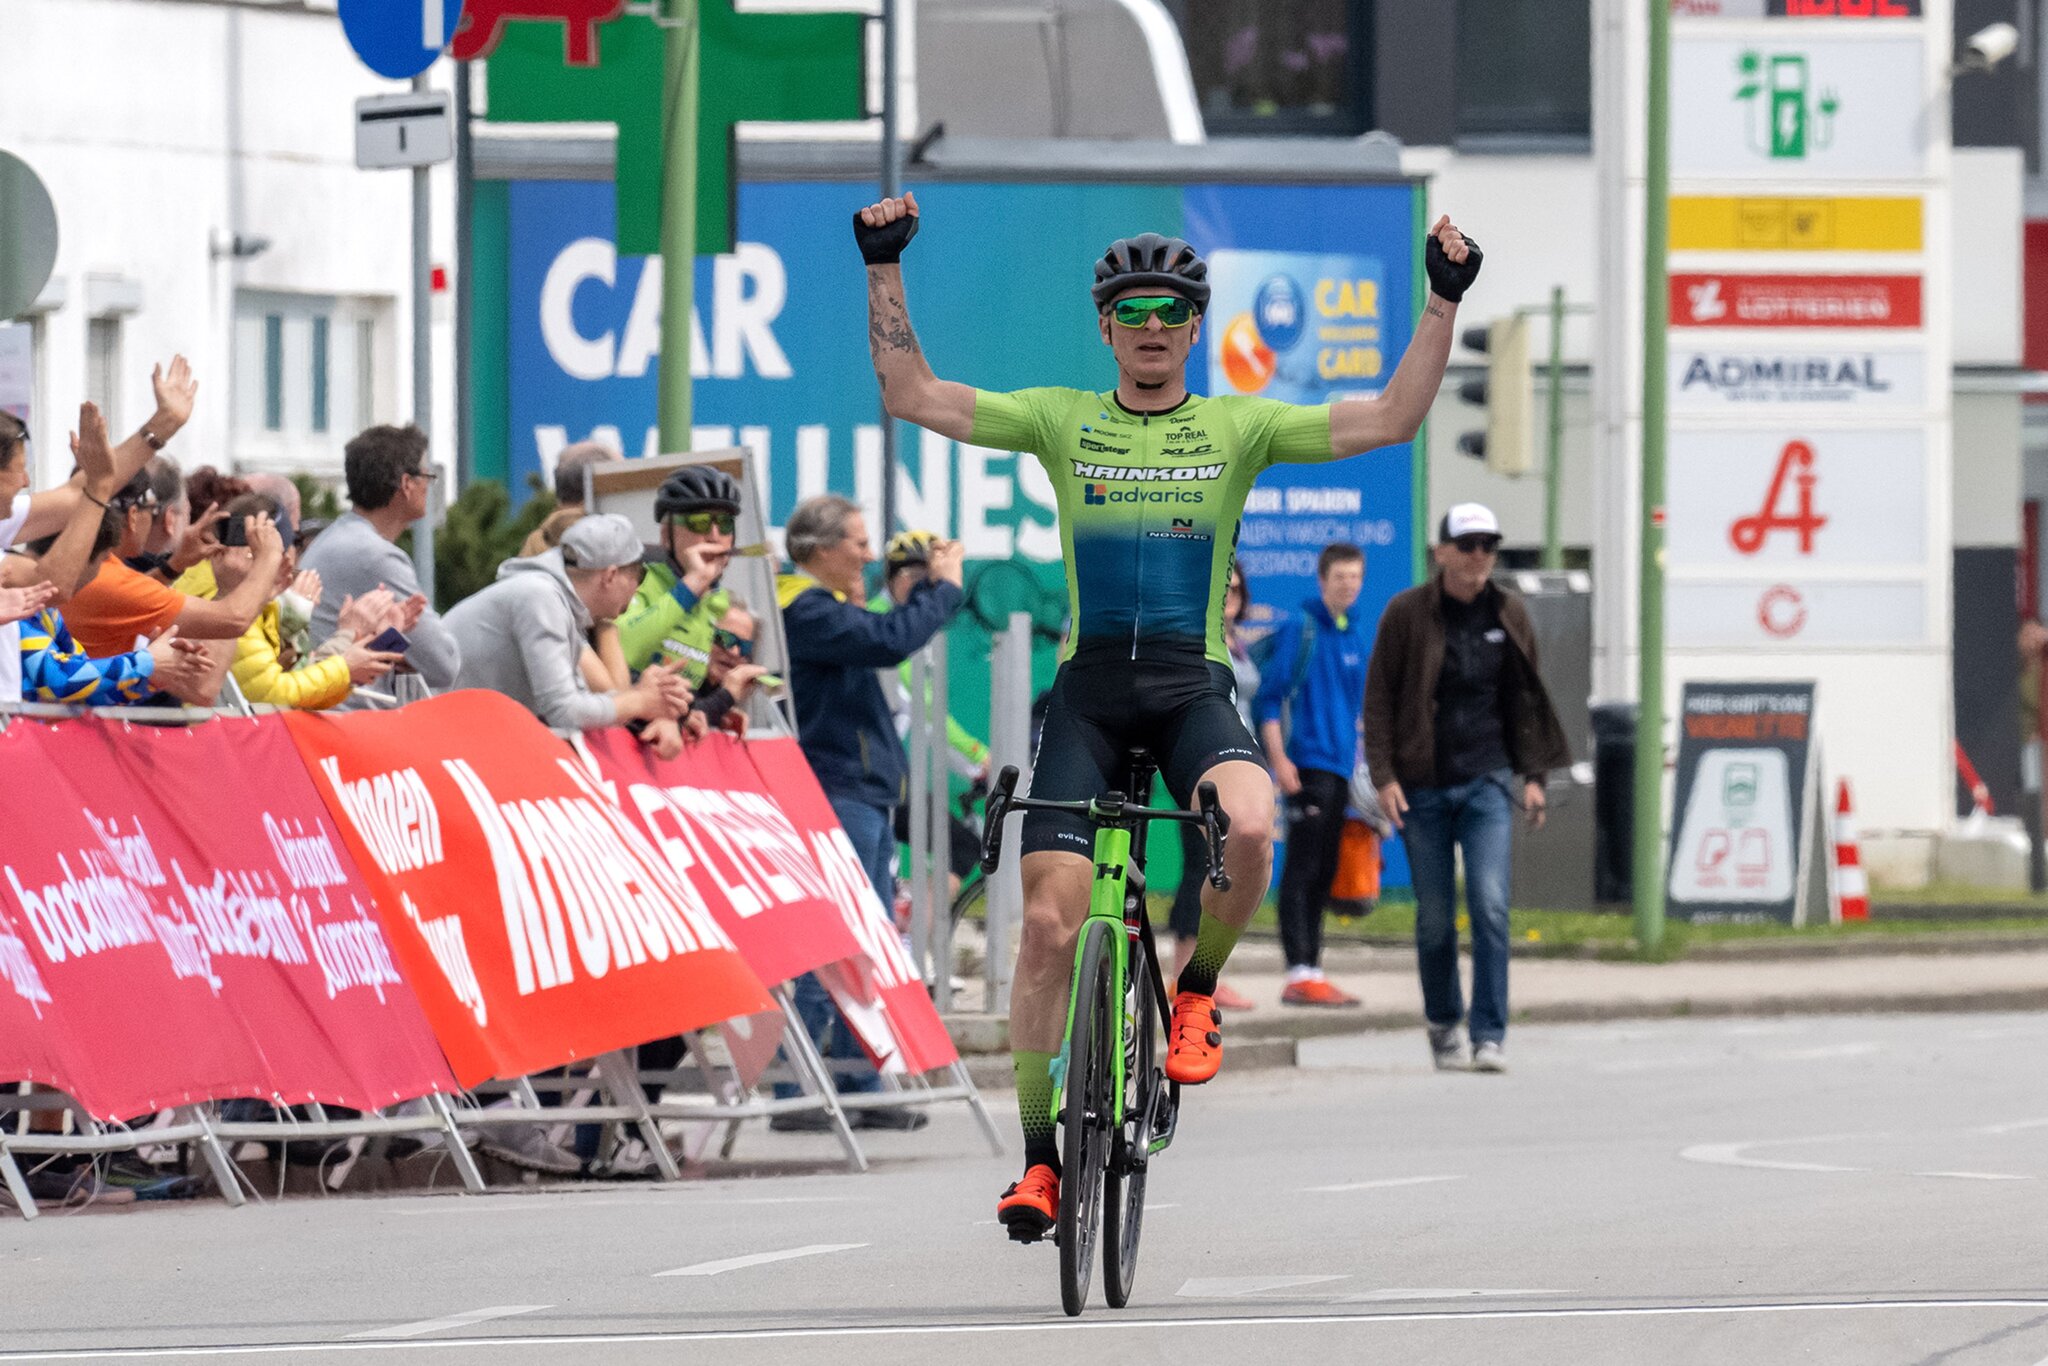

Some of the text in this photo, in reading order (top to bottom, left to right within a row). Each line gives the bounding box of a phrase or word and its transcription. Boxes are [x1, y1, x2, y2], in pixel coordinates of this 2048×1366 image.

[1314, 278, 1379, 317] CAR
[540, 238, 793, 380] CAR
[1317, 346, 1382, 380] CARD
[1682, 353, 1889, 391] ADMIRAL
[1165, 429, 1208, 441] TOP REAL
[1160, 444, 1213, 455] XLC
[1071, 459, 1227, 481] HRINKOW
[1109, 487, 1204, 503] advarics
[1149, 531, 1208, 541] NOVATEC
[1057, 832, 1074, 840] evil
